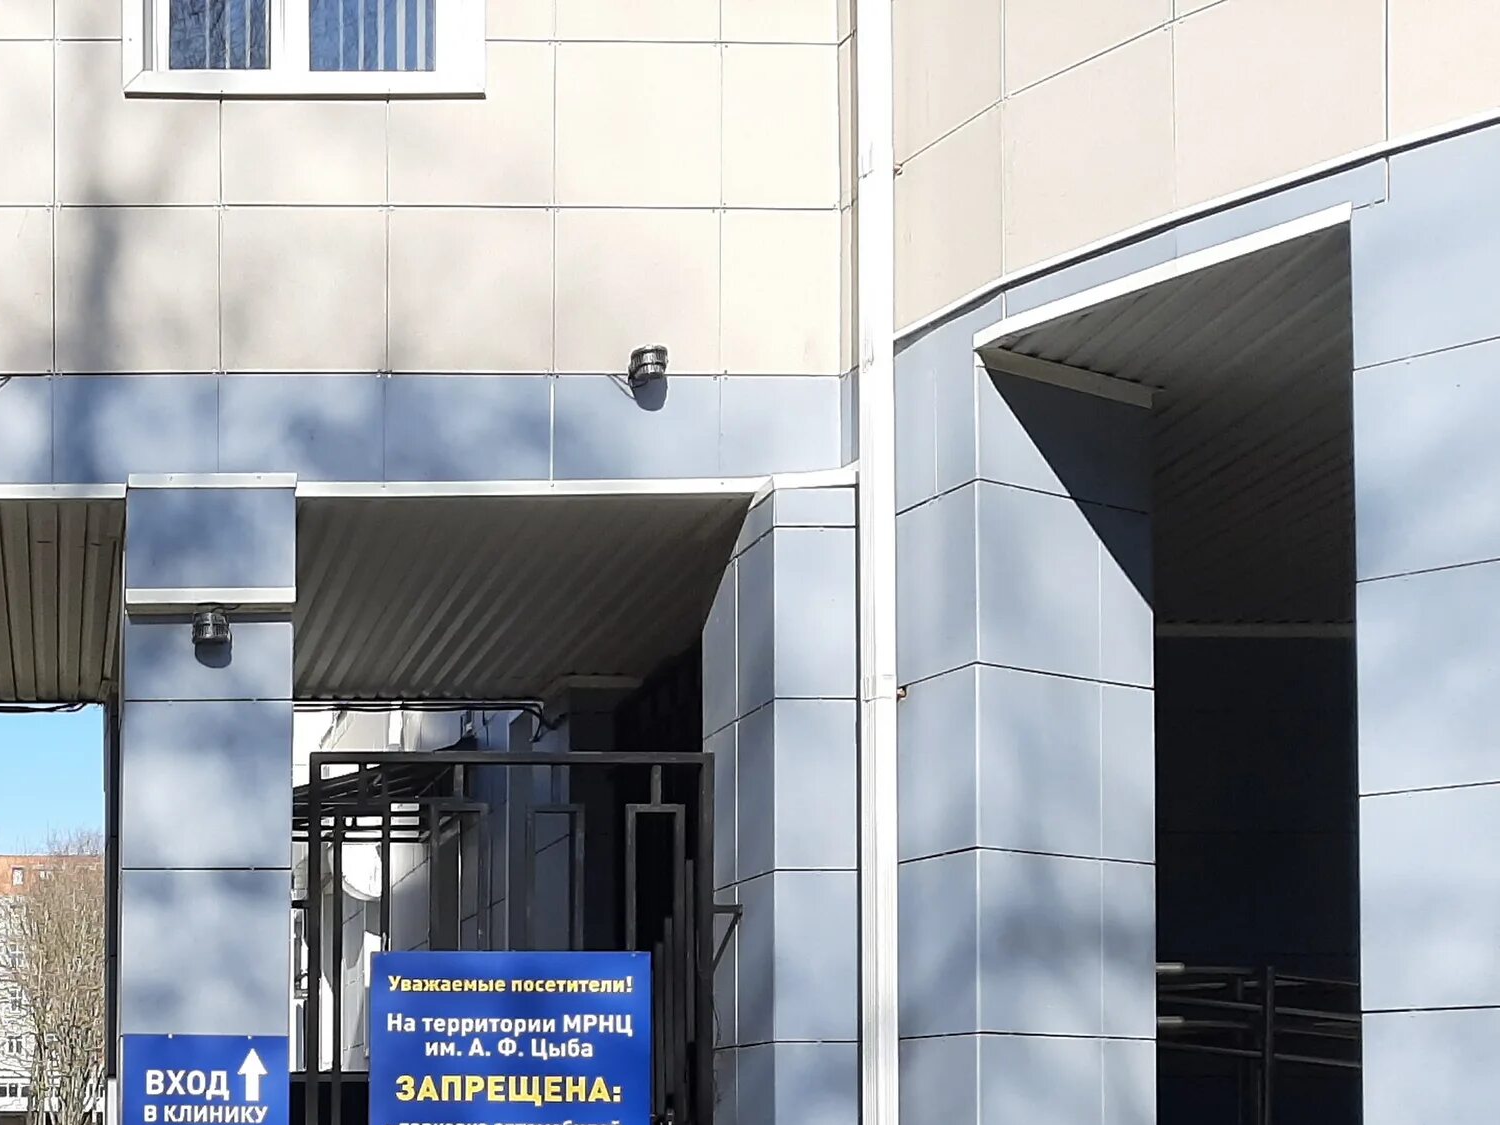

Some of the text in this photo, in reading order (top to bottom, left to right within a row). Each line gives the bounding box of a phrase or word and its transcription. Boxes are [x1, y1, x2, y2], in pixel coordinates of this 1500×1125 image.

[387, 975, 634, 993] Уважаемые посетители!
[386, 1012, 633, 1037] На территории МРНЦ
[425, 1037, 594, 1060] им. А. Ф. Цыба
[145, 1069, 230, 1101] ВХОД
[395, 1074, 622, 1107] ЗАПРЕЩЕНА:
[143, 1104, 269, 1124] В КЛИНИКУ
